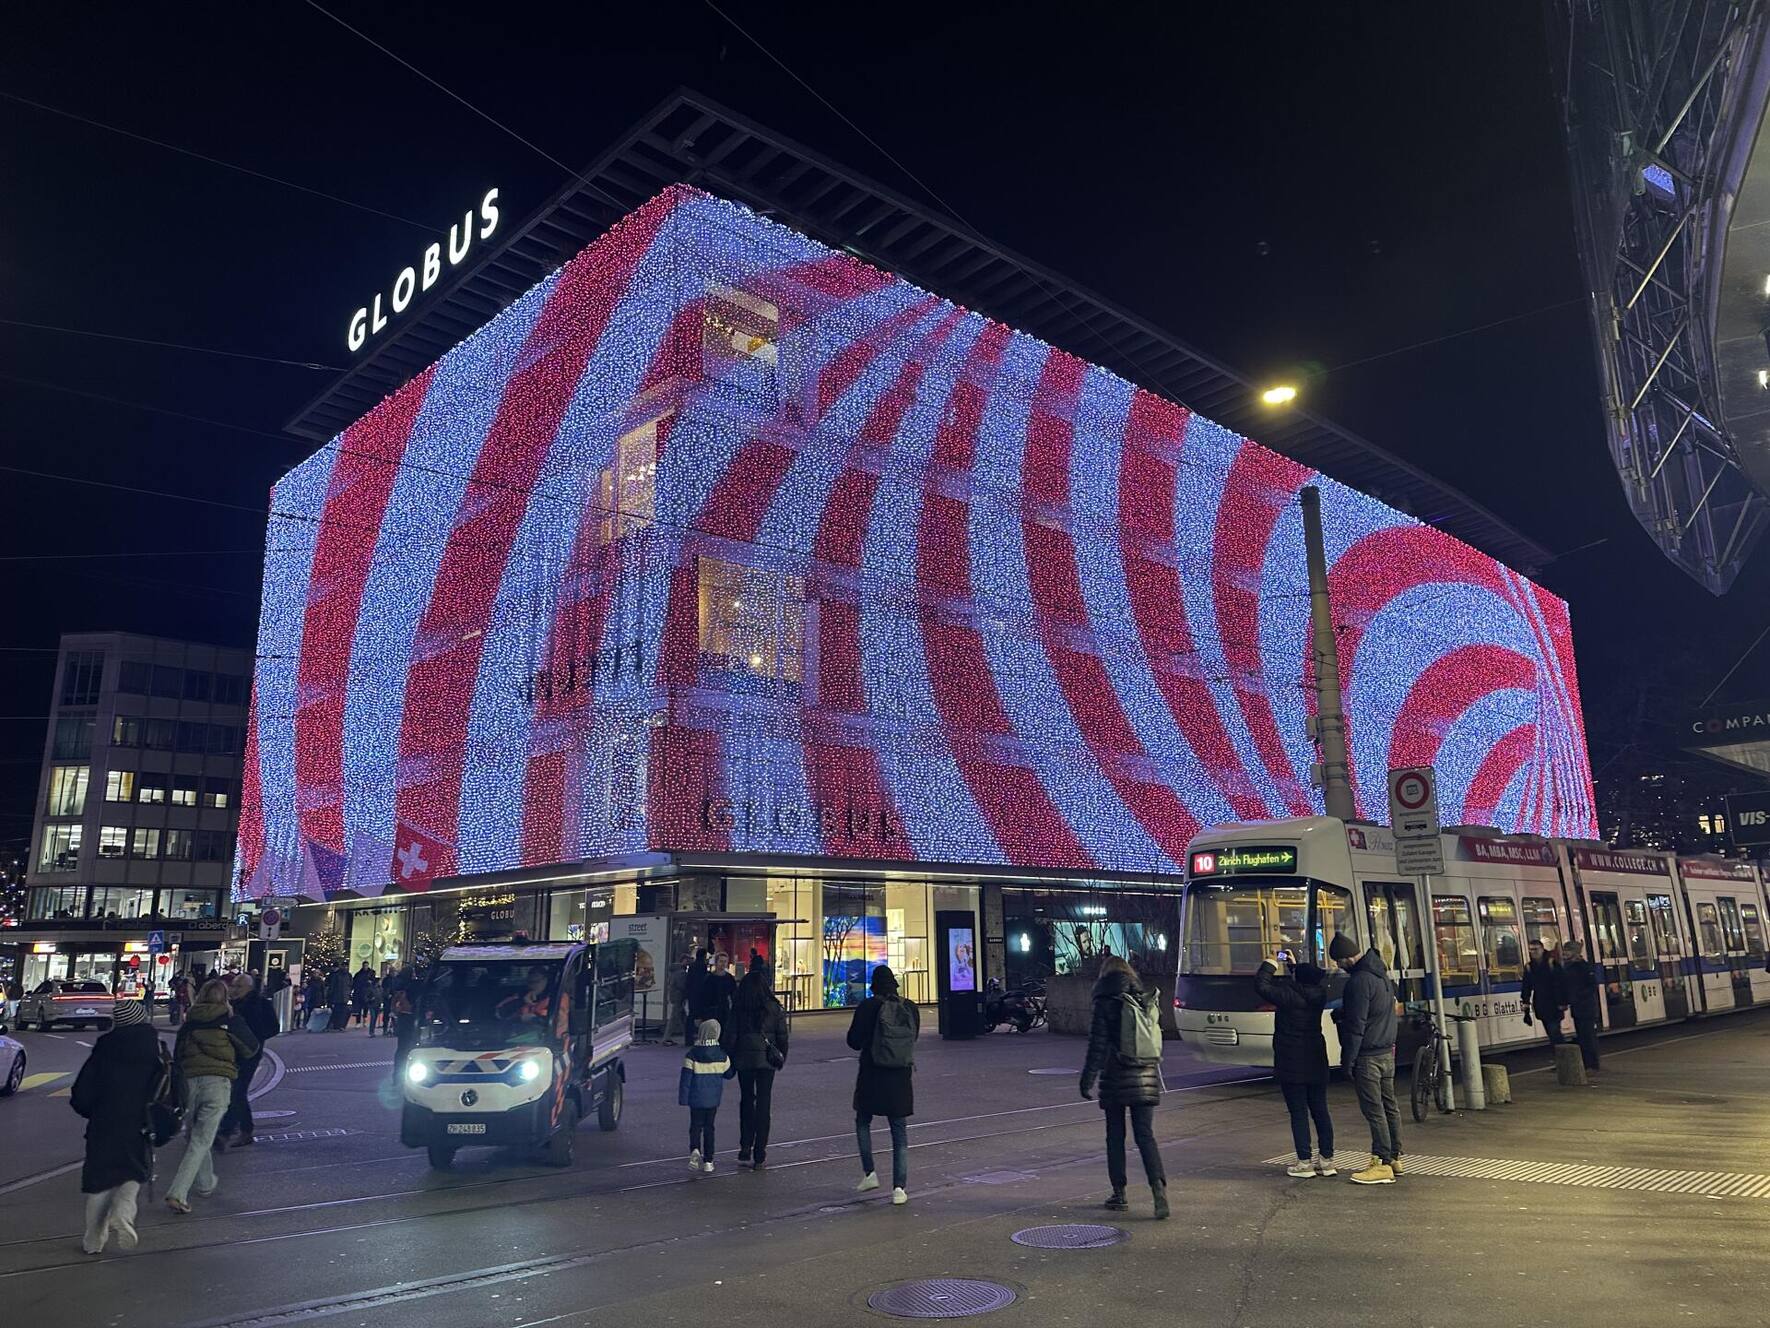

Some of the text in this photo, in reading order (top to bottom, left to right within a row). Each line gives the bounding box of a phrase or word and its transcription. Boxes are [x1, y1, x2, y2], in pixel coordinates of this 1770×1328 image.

[348, 187, 499, 352] GLOBUS
[1692, 713, 1770, 733] COMPA
[1197, 856, 1212, 870] 10
[1243, 853, 1279, 866] Flughafen
[1590, 853, 1658, 872] WWW.COLLEGE.CH
[491, 909, 515, 920] GLOBU
